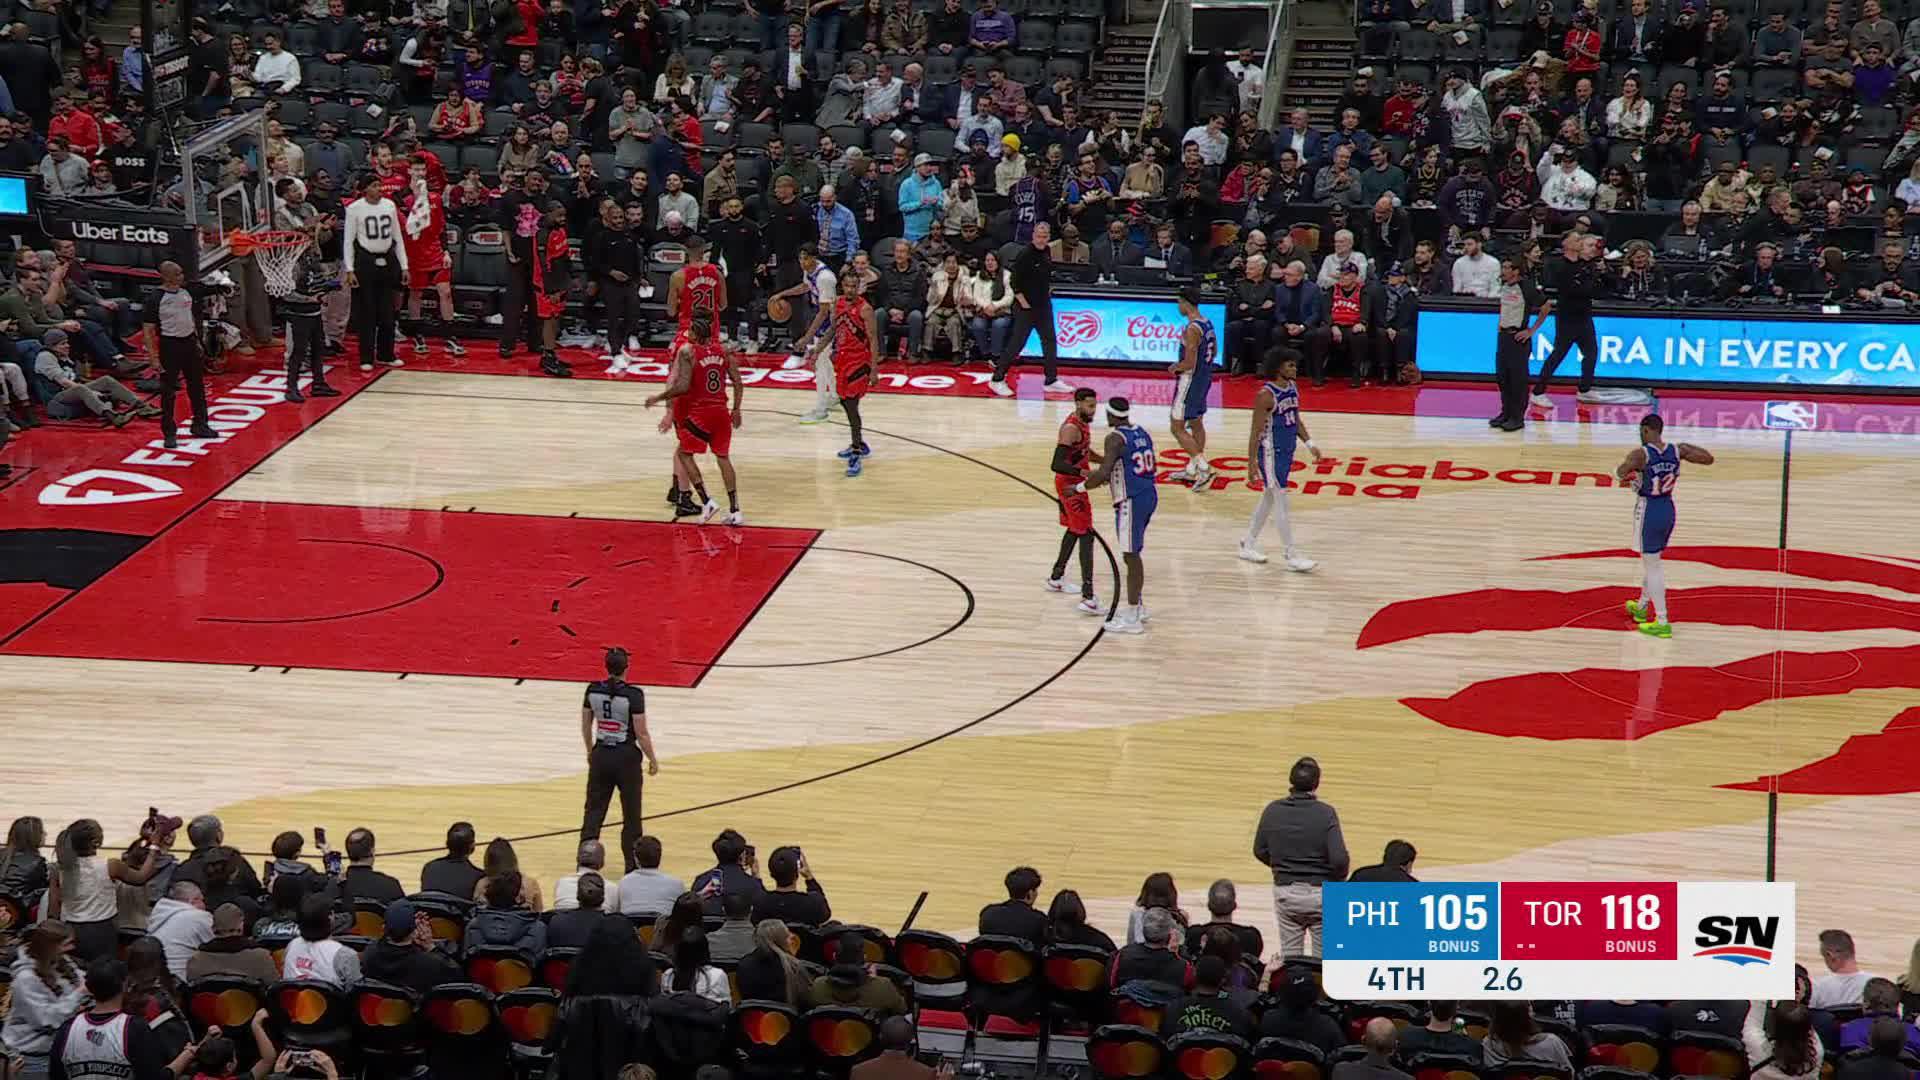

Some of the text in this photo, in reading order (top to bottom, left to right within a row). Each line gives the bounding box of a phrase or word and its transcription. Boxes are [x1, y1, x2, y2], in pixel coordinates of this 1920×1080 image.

[115, 156, 145, 167] BOSS
[72, 221, 169, 245] Uber Eats
[364, 215, 392, 240] 02
[692, 287, 715, 311] 21
[1127, 315, 1185, 340] Coors
[1133, 339, 1180, 352] LIGHT
[1664, 337, 1704, 367] IN
[1720, 338, 1848, 371] EVERY
[706, 368, 721, 394] 8
[1132, 450, 1154, 477] 30
[1651, 474, 1675, 496] 12
[603, 700, 612, 719] 9
